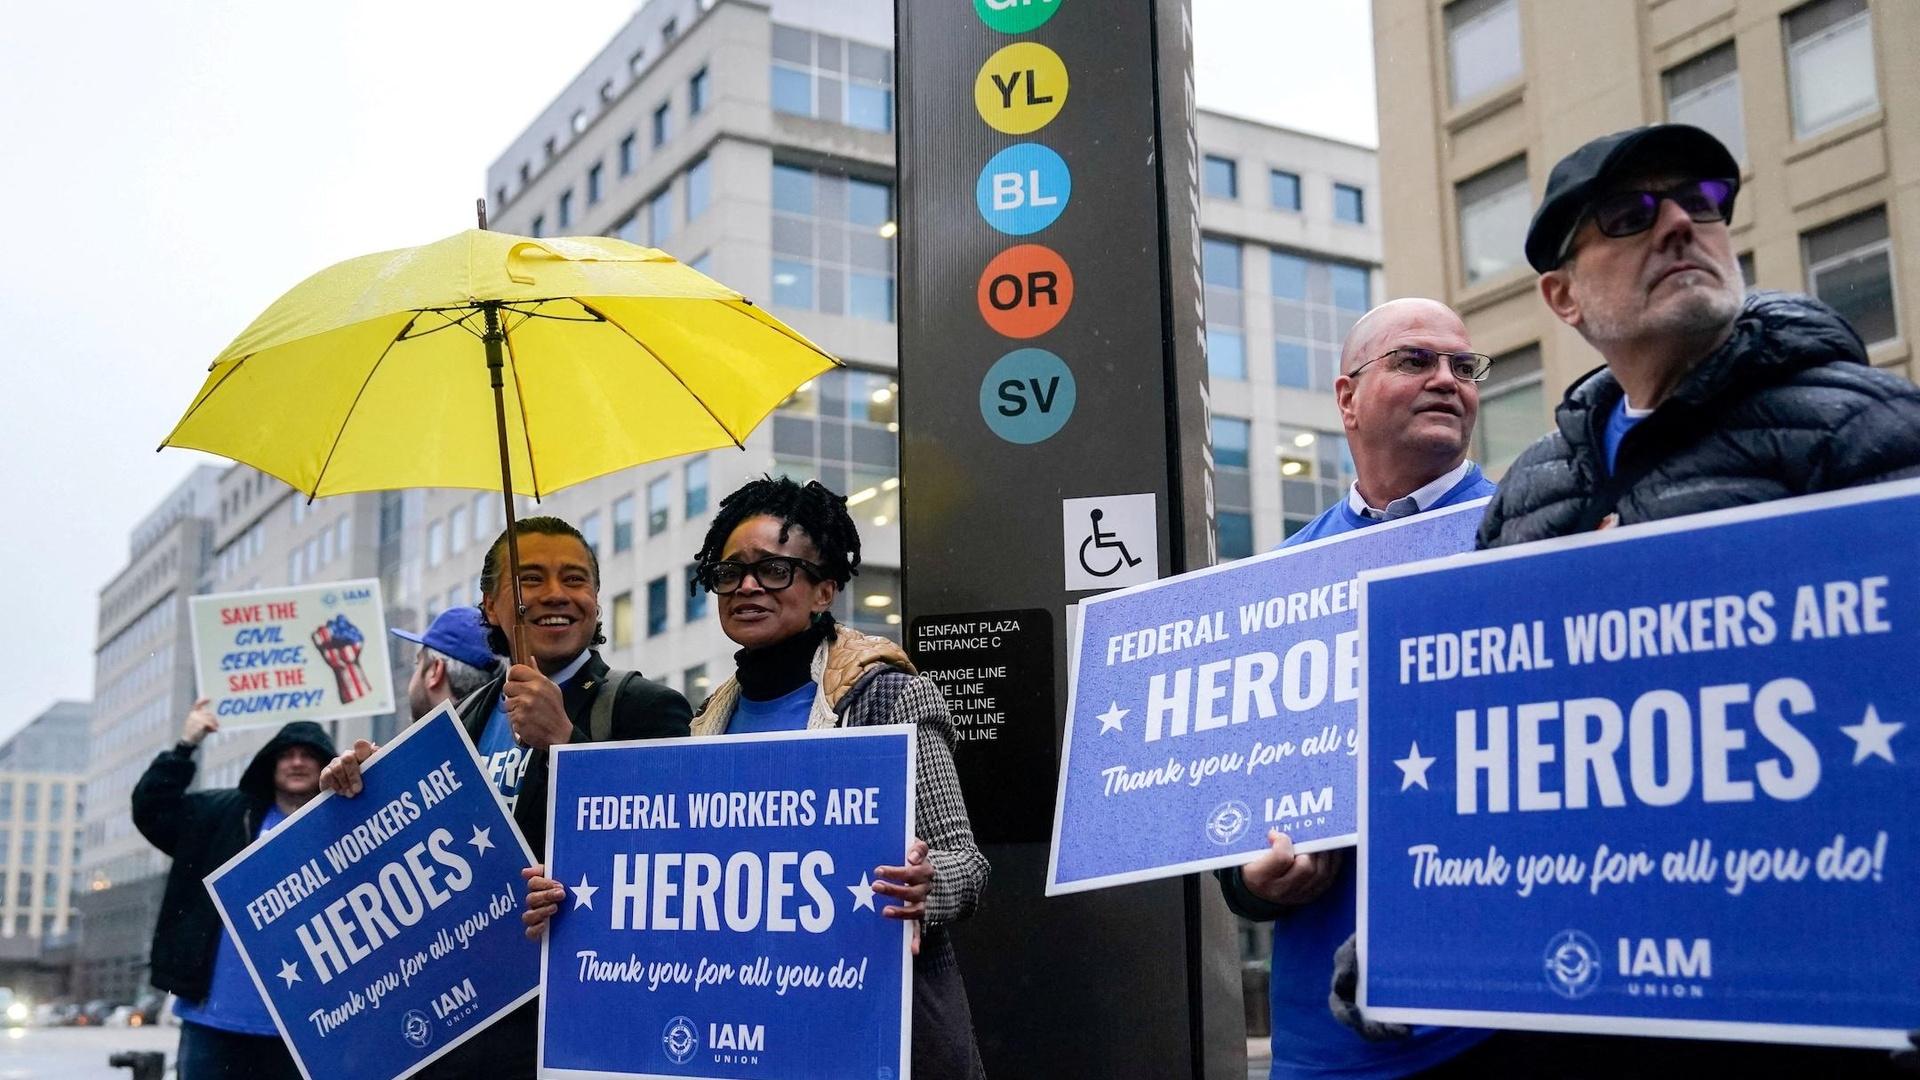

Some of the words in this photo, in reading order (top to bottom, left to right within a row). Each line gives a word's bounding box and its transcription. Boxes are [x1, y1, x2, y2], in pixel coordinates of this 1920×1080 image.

[990, 70, 1053, 108] YL
[992, 169, 1057, 211] BL
[988, 271, 1058, 311] OR
[996, 376, 1061, 417] SV
[1200, 380, 1217, 566] Plaz
[221, 605, 263, 624] SAVE
[266, 601, 297, 620] THE
[918, 623, 976, 637] L'ENFANT
[979, 621, 1020, 633] PLAZA
[1106, 610, 1229, 666] FEDERAL
[1239, 578, 1359, 635] WORKER
[1400, 621, 1553, 685] FEDERAL
[1564, 591, 1777, 665] WORKERS
[1791, 575, 1891, 642] ARE
[235, 626, 284, 646] CIVIL
[918, 638, 988, 652] ENTRANCE
[991, 636, 1001, 648] C
[228, 672, 270, 692] SAVE
[274, 668, 306, 687] THE
[920, 668, 974, 681] ORANGE
[978, 666, 1006, 679] LINE
[956, 683, 984, 695] LINE
[1144, 630, 1359, 742] HEROE
[217, 688, 324, 716] COUNTRY!
[967, 698, 996, 710] LINE
[976, 712, 1005, 725] LINE
[969, 728, 997, 740] LINE
[1455, 677, 1822, 815] HEROES
[1102, 756, 1185, 796] Thank
[1188, 749, 1246, 787] you
[1246, 739, 1296, 775] for
[1301, 725, 1342, 754] all
[577, 794, 681, 831] FEDERAL
[688, 789, 816, 828] WORKERS
[824, 787, 880, 825] ARE
[1265, 786, 1333, 822] IAM
[246, 859, 331, 931] FEDERAL
[323, 792, 421, 874] WORKERS
[417, 760, 462, 810] ARE
[1407, 844, 1512, 889] Thank
[1516, 857, 1586, 897] you
[1590, 844, 1654, 895] for
[1662, 839, 1718, 883] all
[1724, 846, 1811, 896] you
[1816, 831, 1889, 884] do!
[295, 827, 473, 984] HEROES
[610, 850, 835, 933] HEROES
[308, 985, 365, 1038] Thank
[365, 970, 399, 1009] you
[399, 952, 428, 987] for
[429, 929, 455, 962] all
[455, 910, 489, 950] you
[489, 882, 518, 920] do!
[576, 950, 645, 983] Thank
[648, 965, 693, 992] you
[695, 957, 735, 992] for
[739, 956, 773, 986] all
[776, 967, 825, 996] you
[828, 958, 868, 990] do!
[1618, 937, 1712, 978] IAM
[431, 977, 477, 1020] IAM
[1627, 983, 1704, 998] UNION
[446, 1002, 479, 1027] UNION
[709, 1023, 765, 1051] IAM
[714, 1055, 758, 1065] UNION
